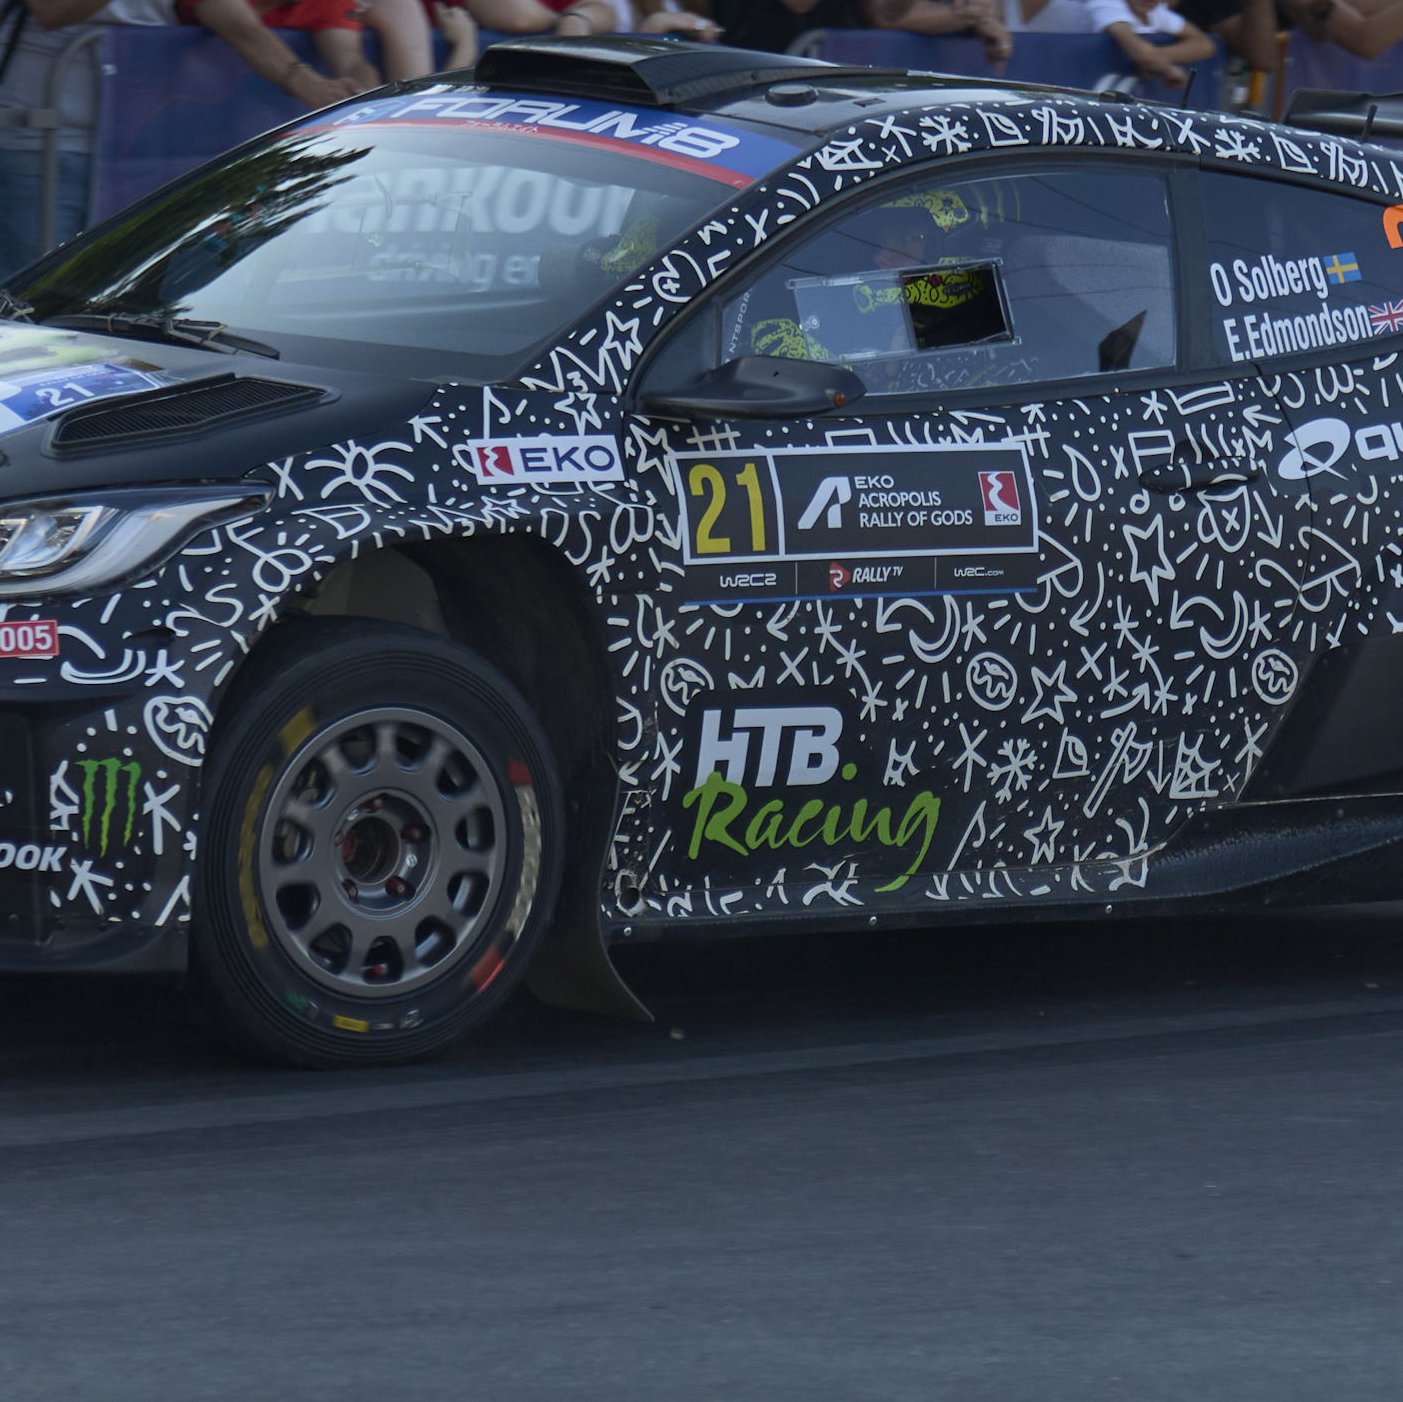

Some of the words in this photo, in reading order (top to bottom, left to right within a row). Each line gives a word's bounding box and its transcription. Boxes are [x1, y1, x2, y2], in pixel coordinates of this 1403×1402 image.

[389, 96, 742, 160] FORUM8
[1209, 263, 1232, 307] O
[1233, 252, 1329, 302] Solberg
[1223, 302, 1373, 363] E.Edmondson
[34, 382, 96, 408] 21
[519, 445, 615, 473] EKO
[854, 474, 895, 489] EKO
[689, 462, 766, 554] 21
[858, 491, 942, 509] ACROPOLIS
[859, 512, 903, 528] RALLY
[907, 511, 928, 527] OF
[930, 509, 973, 526] GODS
[994, 513, 1019, 523] EKO
[683, 771, 942, 893] Racing
